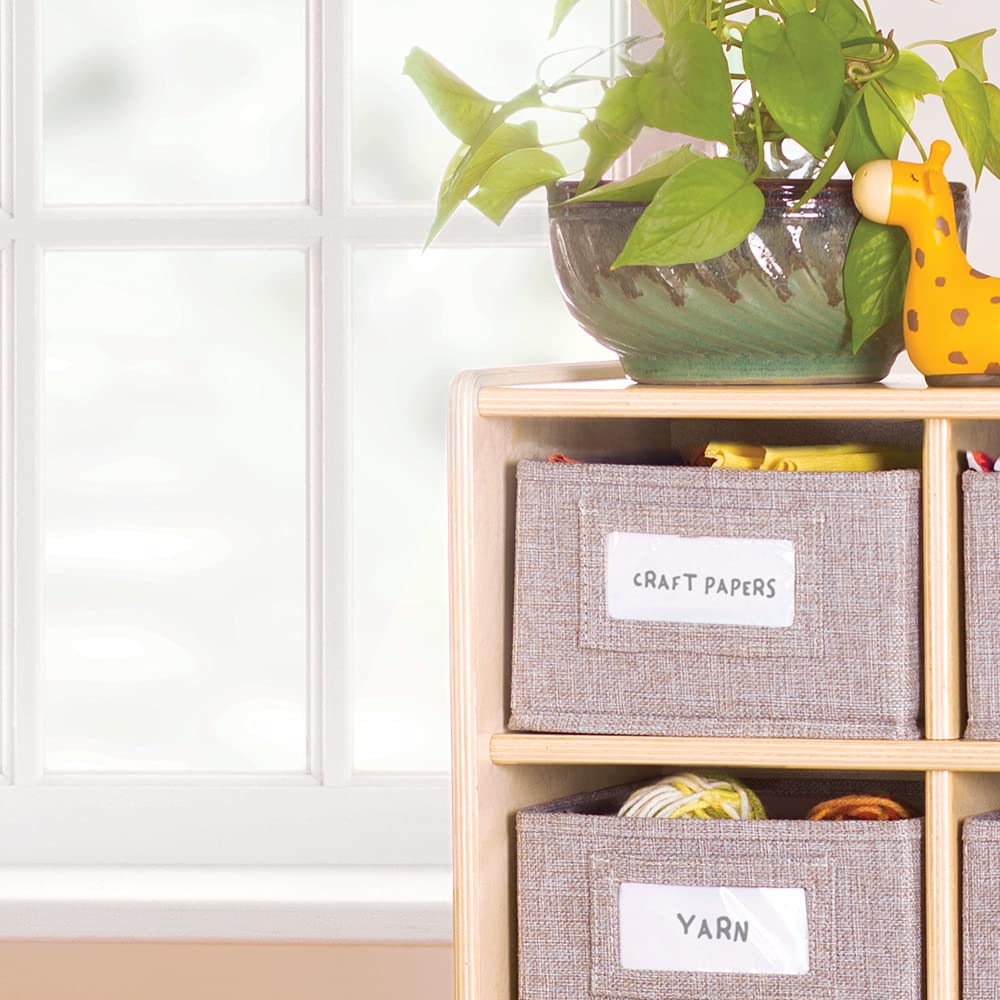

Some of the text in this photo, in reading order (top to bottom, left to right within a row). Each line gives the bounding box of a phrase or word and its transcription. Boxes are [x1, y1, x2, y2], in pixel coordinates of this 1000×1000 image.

[633, 570, 776, 598] CRAFT PAPERS
[677, 913, 749, 942] YARN
